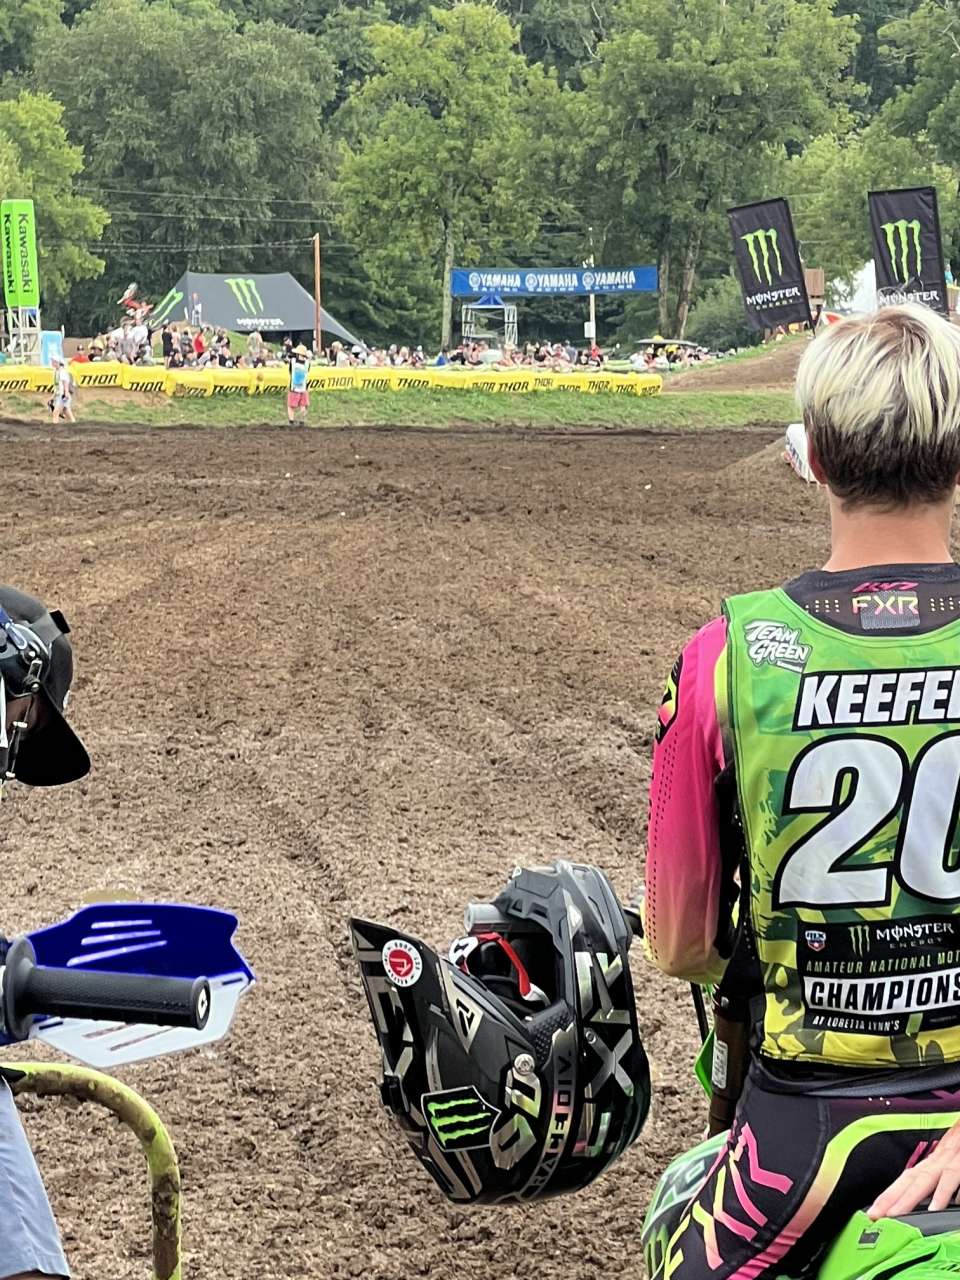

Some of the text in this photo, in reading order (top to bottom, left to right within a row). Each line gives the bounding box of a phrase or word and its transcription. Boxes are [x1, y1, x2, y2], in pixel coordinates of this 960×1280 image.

[4, 213, 15, 293] Kawasaki
[18, 213, 33, 293] Kawasaki
[480, 271, 636, 288] YAMAHA YAMAHA YAMAHA
[746, 287, 800, 305] MONSTER
[81, 374, 118, 385] THOR
[130, 381, 164, 392] THOR
[328, 377, 354, 387] THOR
[398, 378, 429, 388] THOR
[499, 381, 529, 391] THOR
[534, 378, 553, 387] THOR
[588, 381, 610, 390] THOR
[852, 596, 919, 615] FXR
[744, 620, 799, 645] TEAM
[750, 641, 809, 663] GREEN
[876, 922, 954, 942] MONSTER
[806, 960, 863, 974] AMATEUR
[869, 955, 932, 972] NATIONAL
[813, 1015, 900, 1031] AT LORETTA LYNN'S
